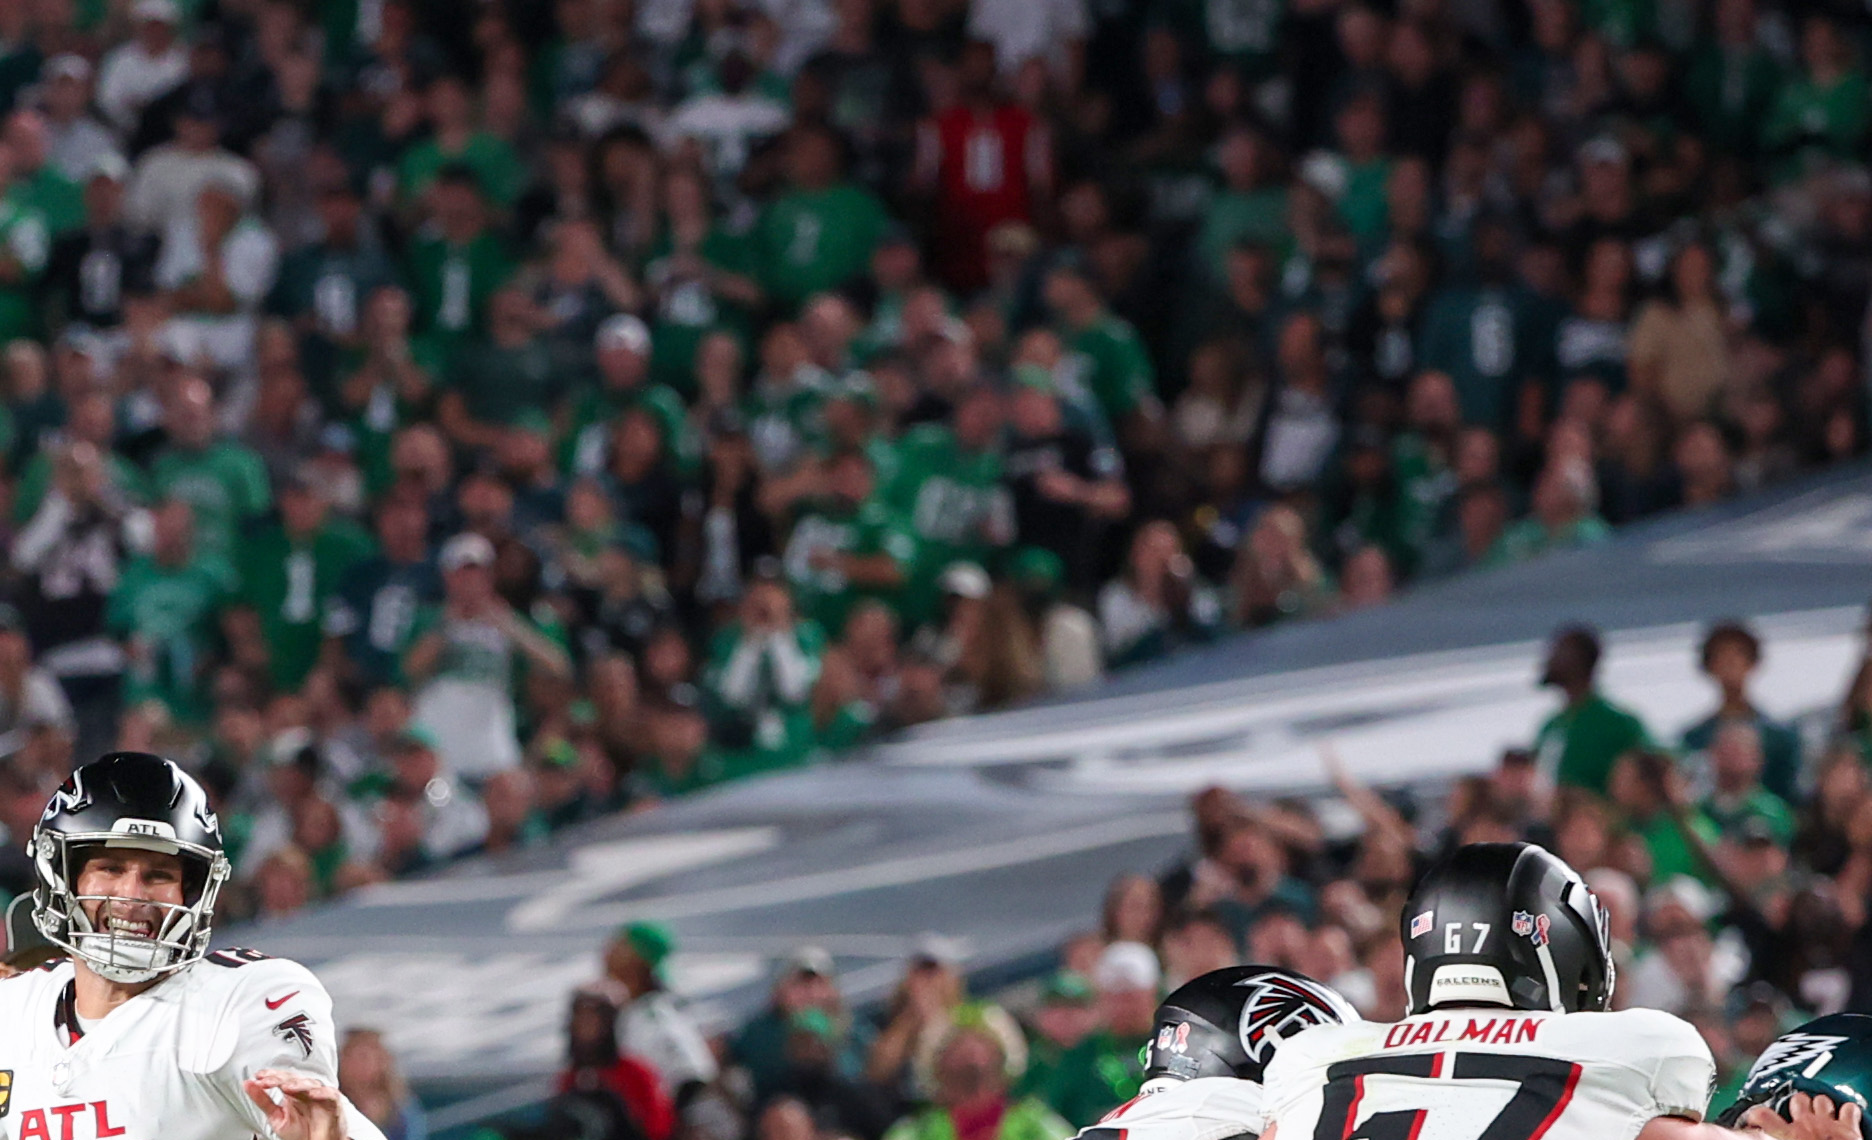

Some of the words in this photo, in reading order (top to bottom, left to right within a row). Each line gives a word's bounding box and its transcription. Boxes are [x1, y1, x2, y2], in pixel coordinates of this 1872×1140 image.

[128, 823, 159, 835] ATL
[1444, 922, 1491, 954] 67
[1436, 975, 1501, 988] FALCONS
[1383, 1017, 1546, 1049] DALMAN
